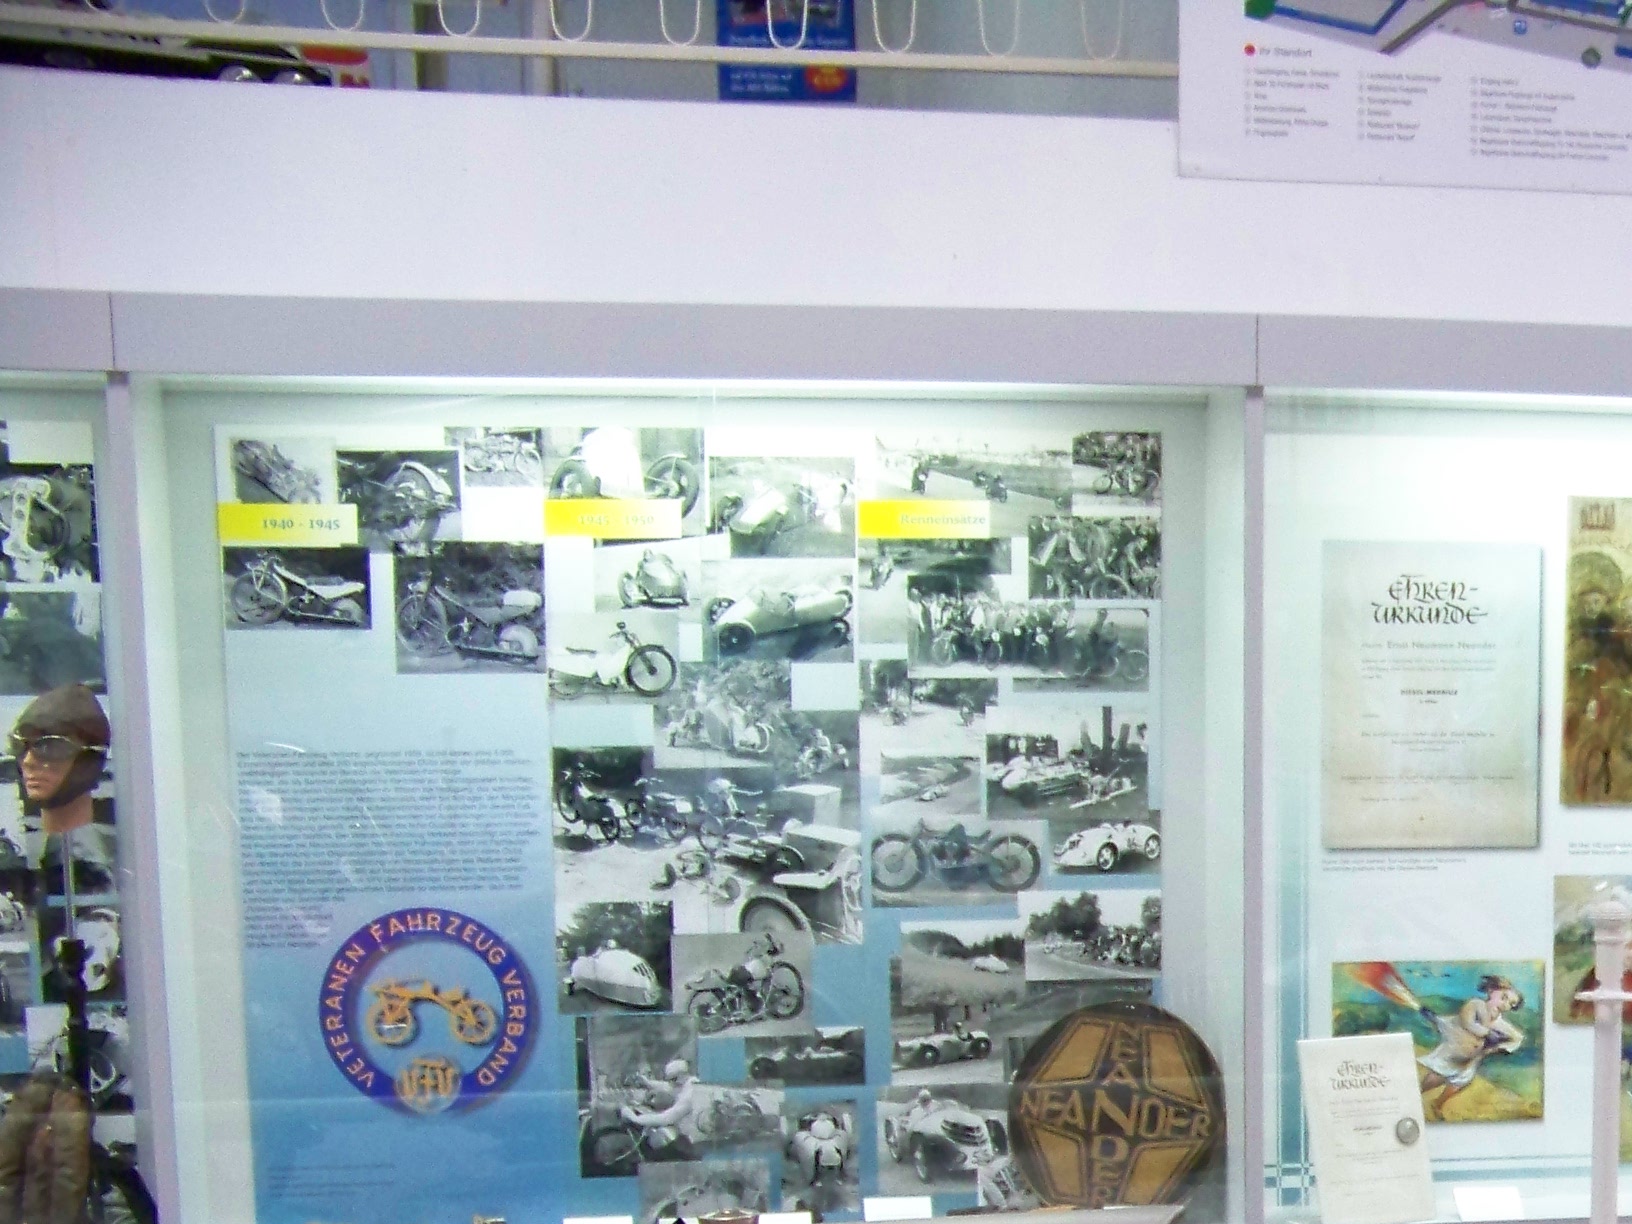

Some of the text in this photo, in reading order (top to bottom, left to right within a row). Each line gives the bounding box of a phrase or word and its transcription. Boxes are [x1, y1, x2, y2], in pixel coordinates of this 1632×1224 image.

[262, 518, 294, 530] 1940
[308, 518, 340, 531] 1945
[580, 514, 609, 526] 1945
[624, 514, 655, 526] 1950
[900, 513, 986, 526] Renneinsätze
[325, 943, 375, 1088] VETERANEN
[369, 913, 506, 965] FAHRZEUG
[476, 968, 527, 1086] VERBAND
[1020, 1088, 1211, 1139] NEANDER
